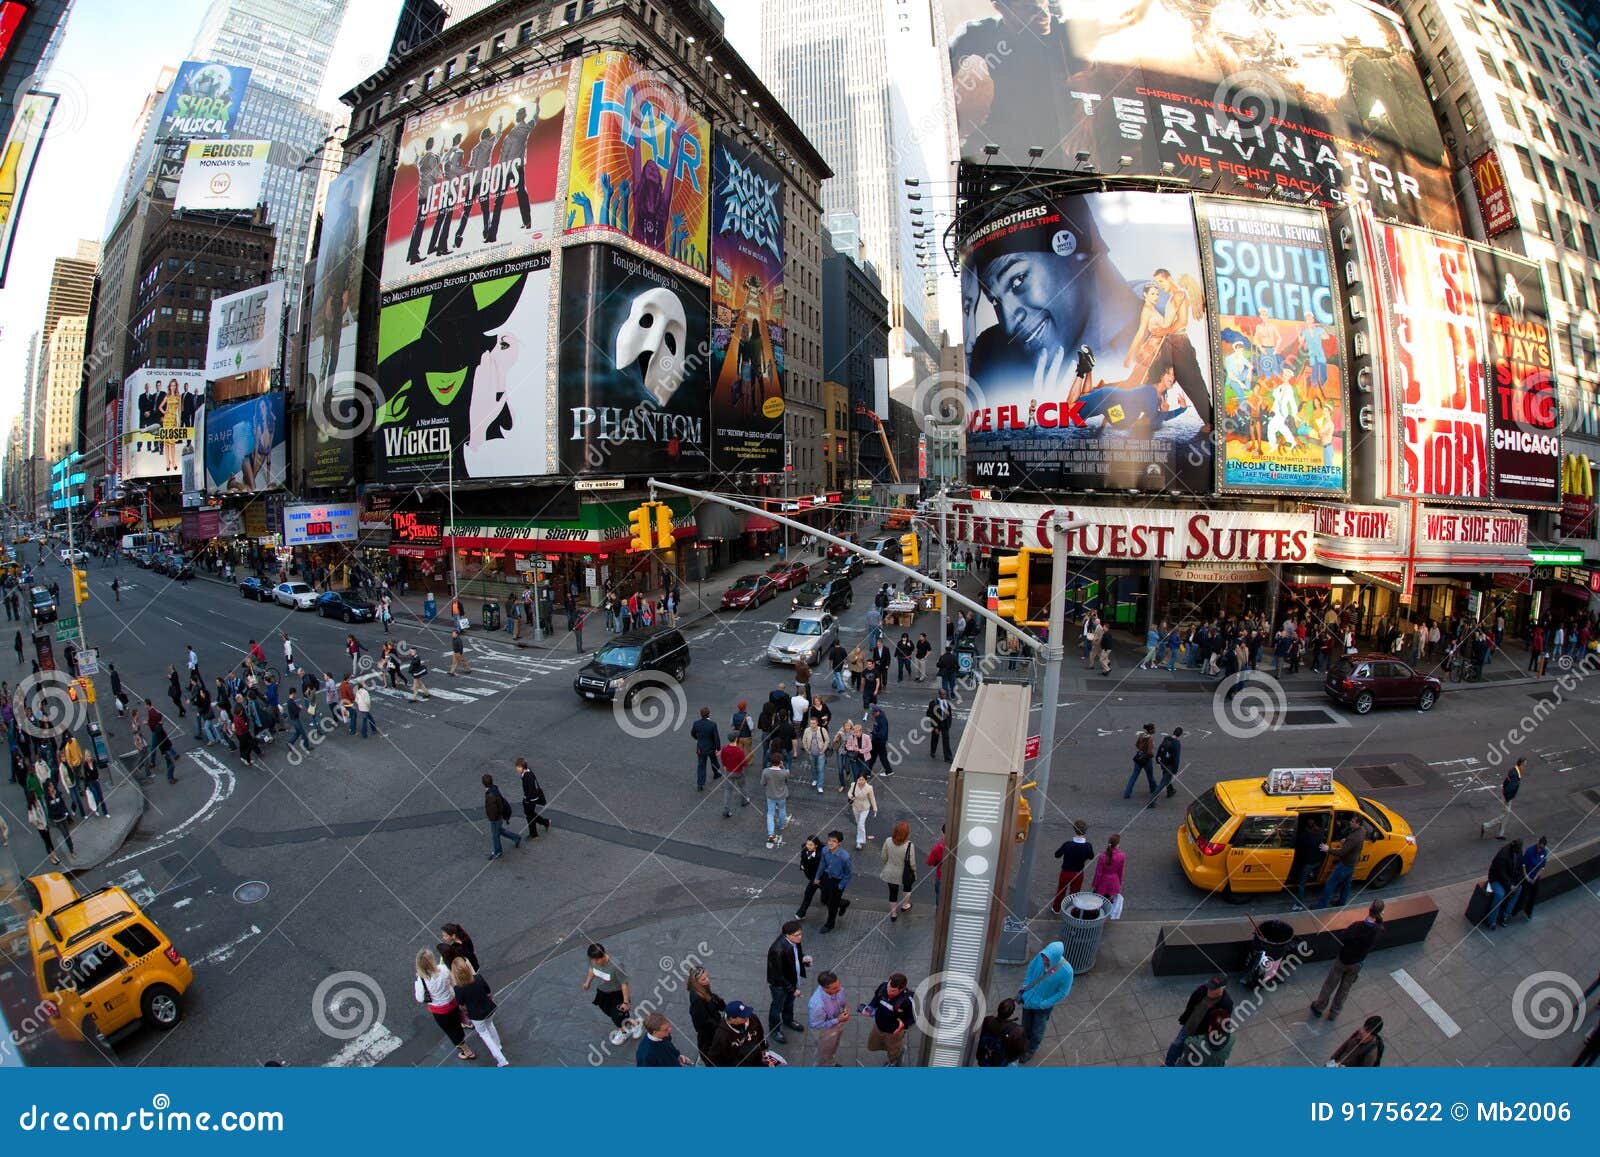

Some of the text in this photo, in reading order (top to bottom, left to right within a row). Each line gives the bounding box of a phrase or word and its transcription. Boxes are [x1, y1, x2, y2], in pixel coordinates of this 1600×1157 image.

[173, 94, 232, 120] SHREK
[407, 64, 569, 132] BEST MUSICAL
[169, 116, 228, 133] MUSICAL
[587, 79, 702, 194] HAIR
[1136, 86, 1379, 158] CHRISTIAN BALE SAM WORTHINGTON
[211, 144, 254, 157] CLOSER
[1070, 91, 1421, 200] TERMINATOR
[1119, 122, 1398, 204] SALVATION
[1178, 152, 1324, 196] WE FIGHT BACK
[421, 158, 521, 215] JERSEY BOYS
[720, 144, 780, 214] ROCK
[1485, 189, 1503, 205] OPEN
[1490, 199, 1505, 217] 24
[720, 195, 781, 263] AGES
[992, 205, 1047, 231] BROTHERS
[1008, 224, 1017, 233] OF
[1020, 221, 1036, 229] ALL
[1037, 215, 1060, 224] TIME
[1209, 217, 1323, 243] BEST MUSICAL REVIVAL
[1489, 212, 1511, 229] HOURS
[612, 250, 642, 275] Tonight
[643, 262, 670, 288] belongs
[1214, 239, 1330, 288] SOUTH
[383, 256, 550, 304] SO MUCH HAPPENED BEFORE DOROTHY DROPPED IN
[221, 291, 268, 326] THE
[1217, 276, 1335, 326] PACIFIC
[1340, 225, 1376, 432] PALACE
[1489, 311, 1547, 343] BROAD
[1492, 332, 1550, 367] WAY'S
[160, 429, 188, 439] CLOSER
[570, 407, 702, 444] PHANTOM
[1404, 415, 1488, 498] STORY
[1493, 428, 1559, 457] CHICAGO
[977, 462, 995, 476] MAY
[997, 462, 1010, 476] 22
[1227, 461, 1341, 474] LINCOLN CENTER THEATER
[595, 480, 619, 488] outdoor
[980, 490, 992, 499] FUEL
[307, 523, 331, 535] GIFTS
[407, 525, 438, 540] STEAKS
[448, 526, 480, 537] sbarro
[494, 527, 531, 539] sbarro
[545, 528, 589, 541] sbarro
[604, 525, 631, 540] sbarr
[1037, 509, 1175, 558] GUEST
[1186, 514, 1307, 561] SUITES
[1319, 507, 1339, 536] SIDE
[1344, 511, 1389, 538] STORY
[1427, 514, 1522, 543] WEST SIDE STORY
[1533, 568, 1552, 580] SHOP
